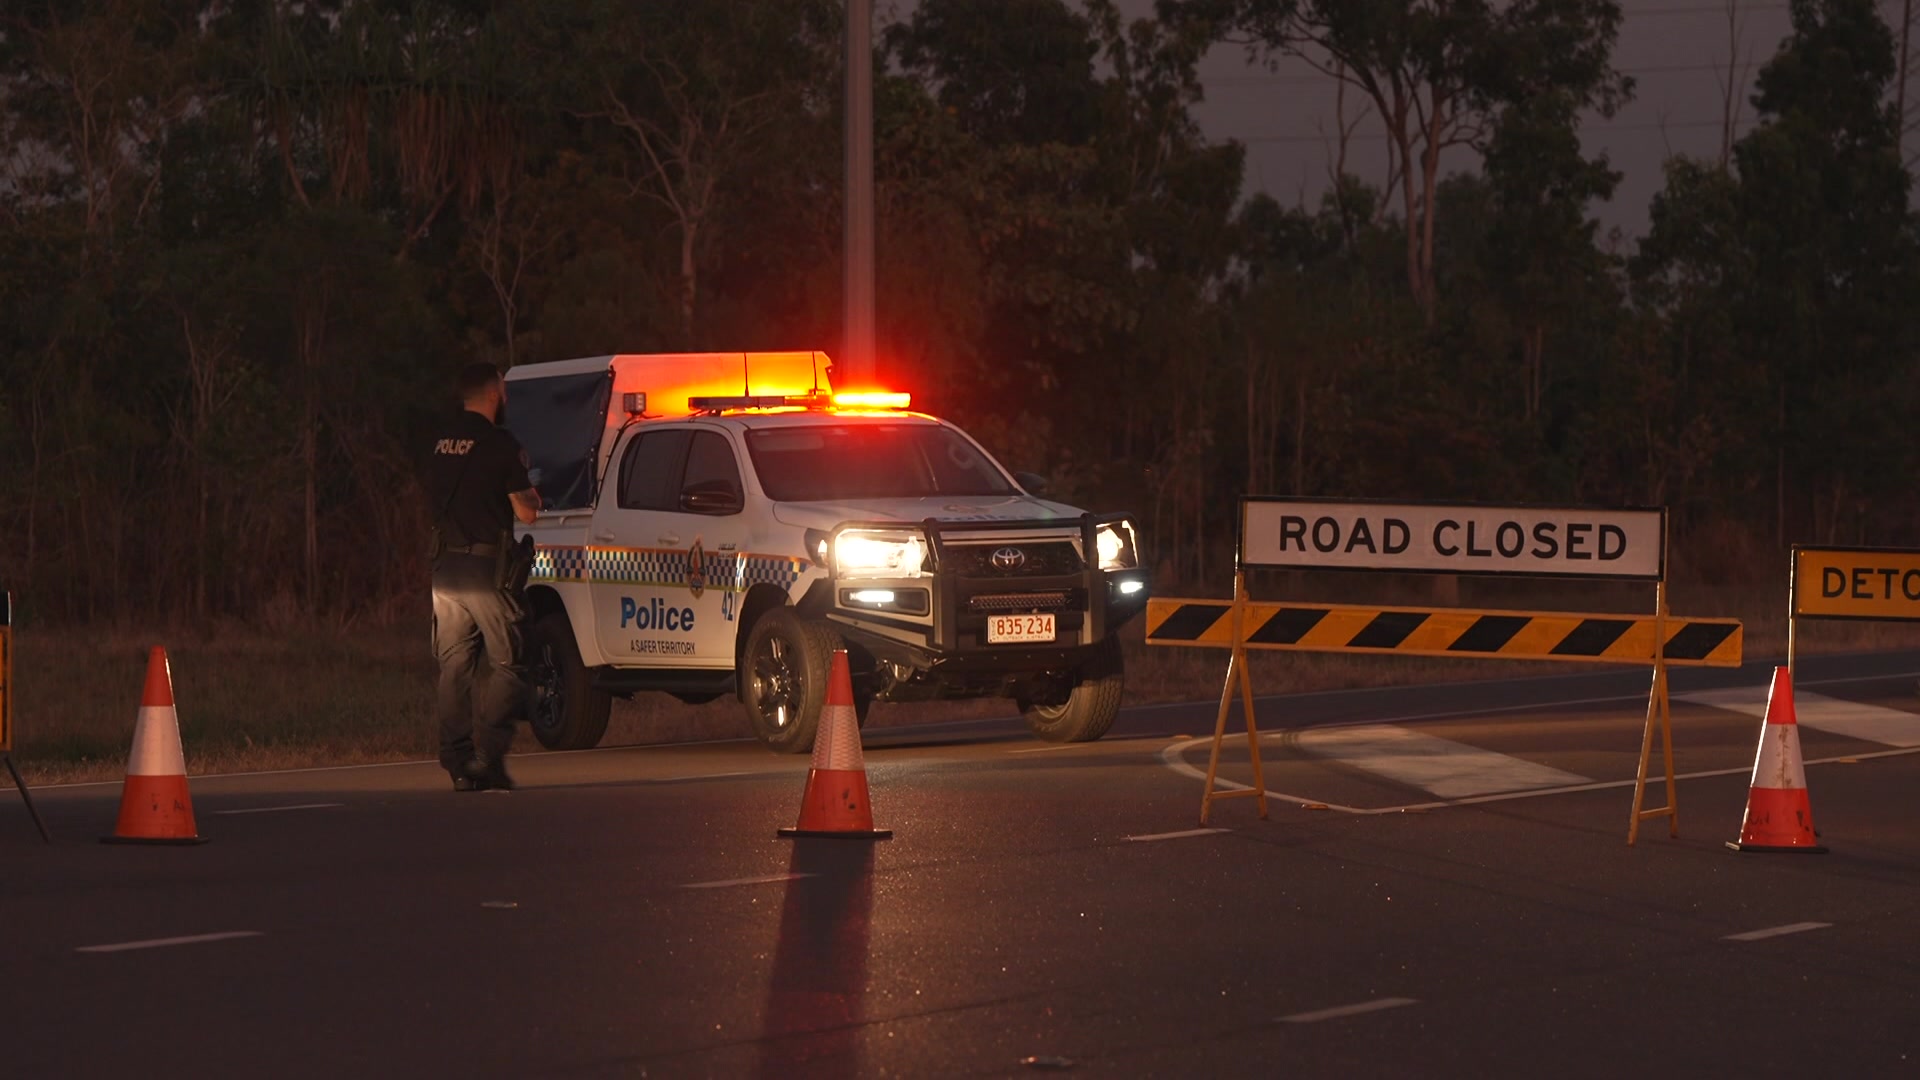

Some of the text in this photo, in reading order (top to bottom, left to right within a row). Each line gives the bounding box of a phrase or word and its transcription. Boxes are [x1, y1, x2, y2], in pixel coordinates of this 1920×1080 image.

[1279, 515, 1627, 560] ROAD CLOSED
[1822, 567, 1920, 600] DETO
[621, 597, 694, 631] Police
[722, 591, 733, 621] 42
[997, 618, 1022, 635] 835
[1026, 617, 1052, 635] 234
[630, 640, 695, 655] A SAFER TERRITORY
